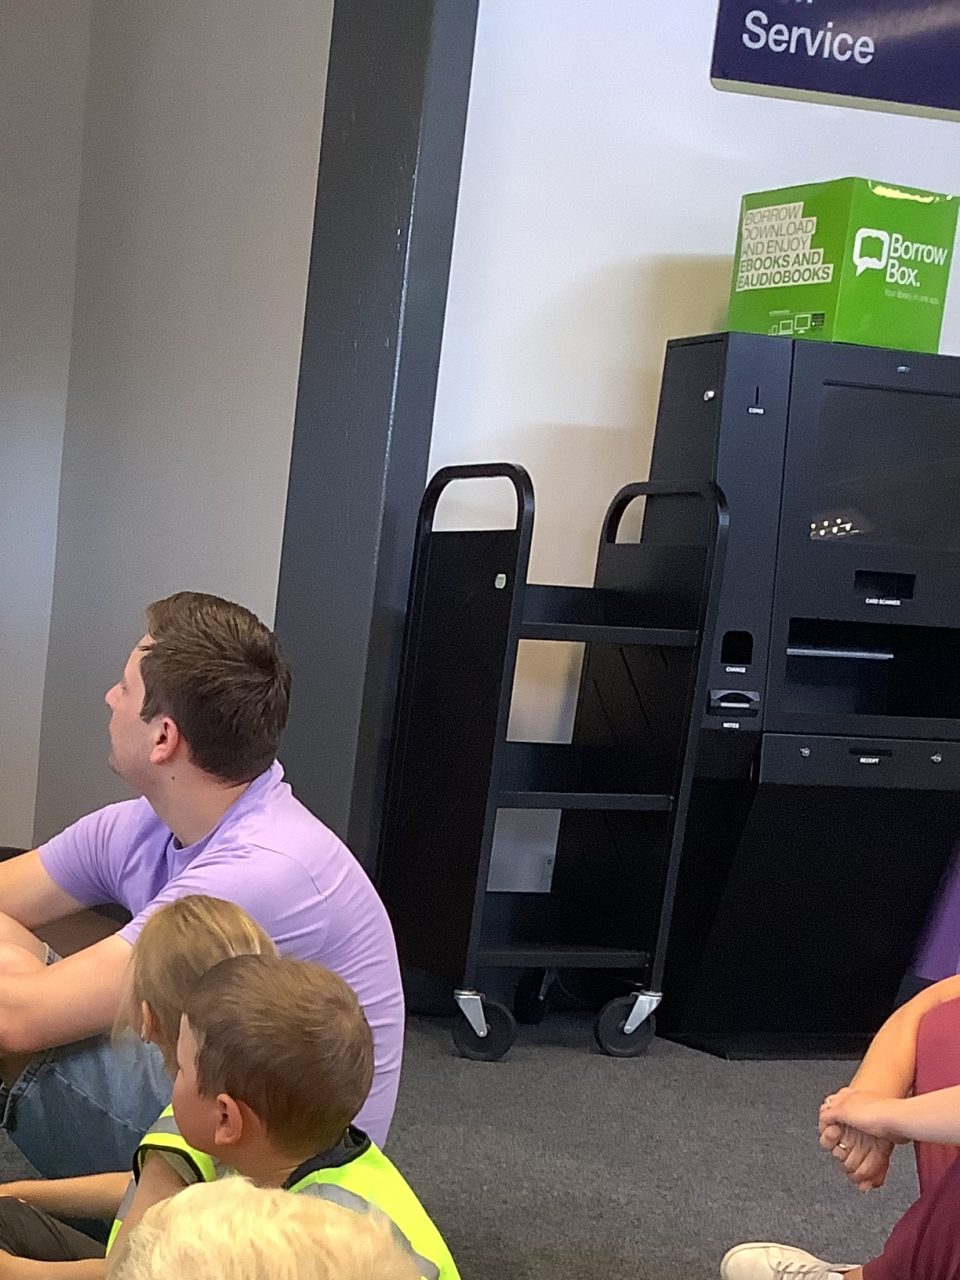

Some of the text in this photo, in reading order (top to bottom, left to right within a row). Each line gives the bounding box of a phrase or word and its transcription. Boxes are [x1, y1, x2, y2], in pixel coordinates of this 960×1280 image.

[742, 9, 875, 64] Service
[744, 204, 802, 226] BORROW
[767, 236, 810, 254] ENJOY
[889, 233, 949, 266] Borrow
[740, 251, 821, 274] EBOOKS AND
[885, 259, 921, 287] Box.
[738, 266, 831, 289] EAUDIOBOOKS
